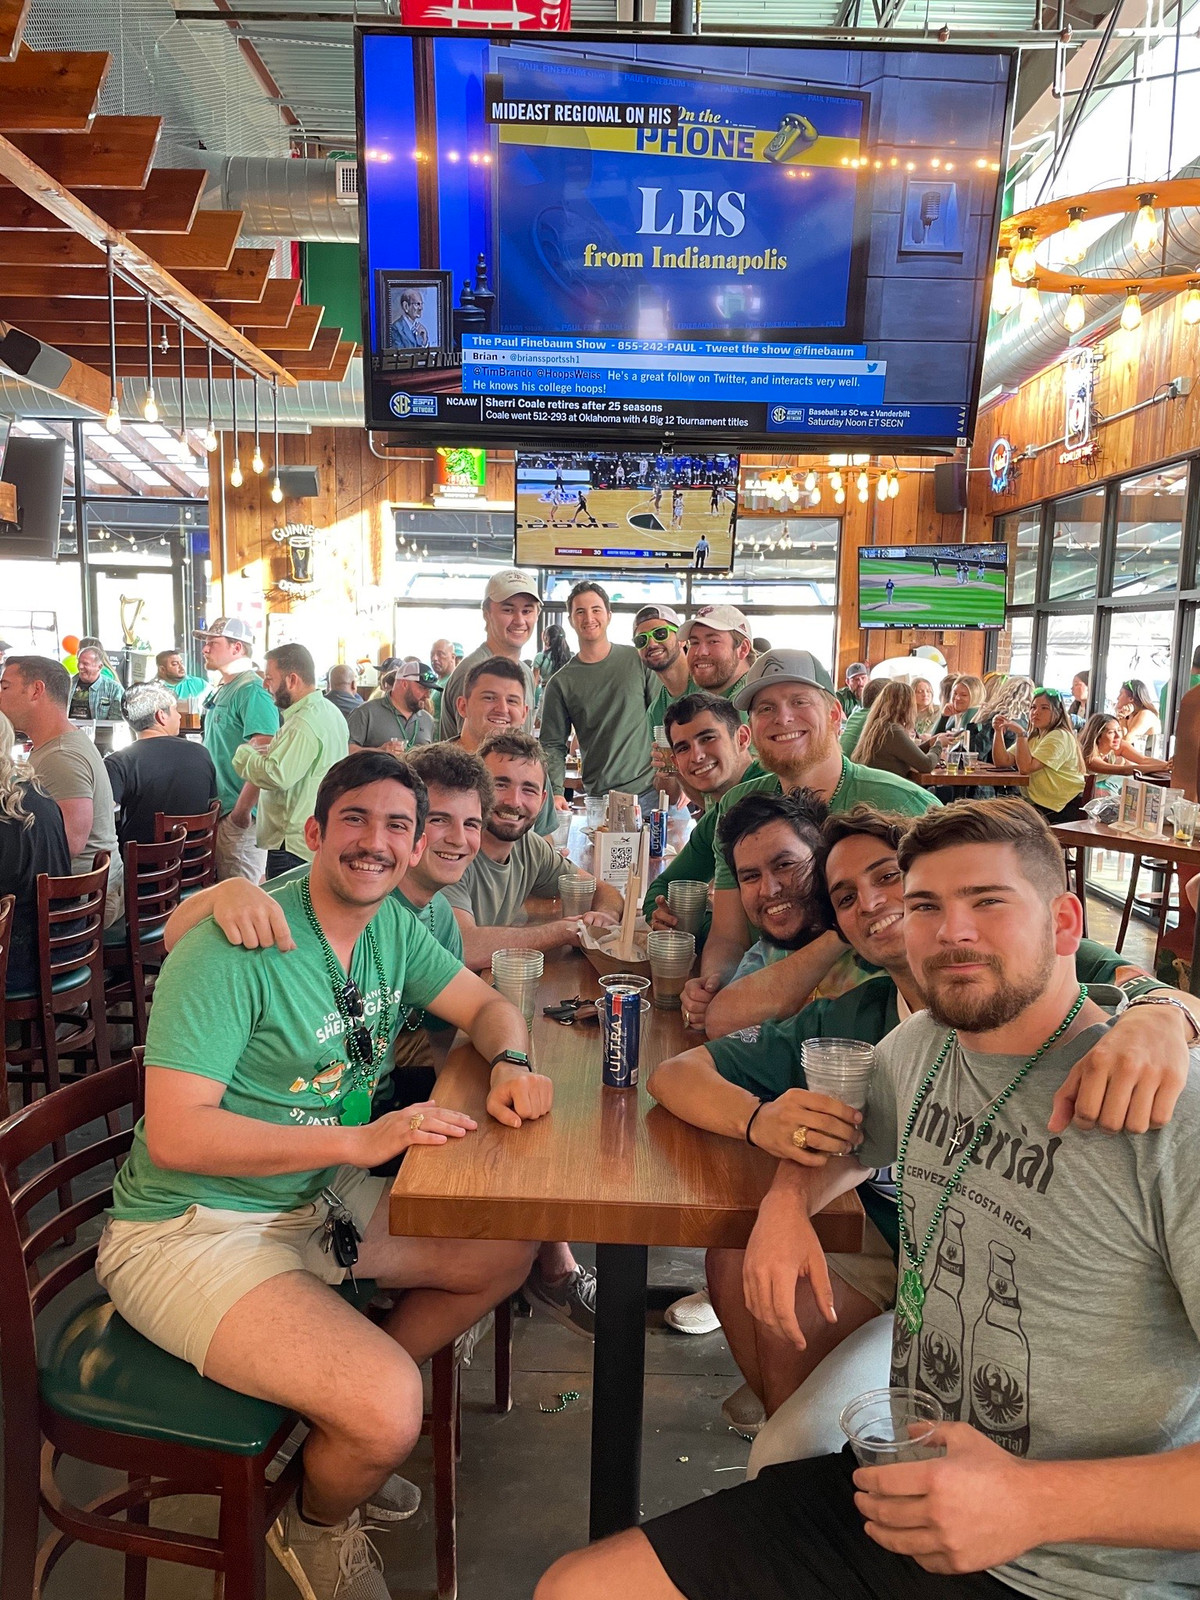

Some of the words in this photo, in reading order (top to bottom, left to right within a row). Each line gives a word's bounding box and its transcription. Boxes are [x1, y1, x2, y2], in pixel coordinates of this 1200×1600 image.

[491, 102, 552, 121] MIDEAST
[554, 104, 622, 124] REGIONAL
[625, 106, 645, 124] ON
[648, 107, 672, 125] HIS
[699, 108, 722, 124] the
[636, 126, 755, 160] PHONE
[635, 187, 746, 238] LES
[583, 243, 644, 268] from
[651, 246, 788, 275] Indianapolis
[472, 336, 492, 346] The
[494, 337, 518, 347] Paul
[521, 338, 574, 349] Finebaum
[576, 340, 607, 350] Show
[617, 341, 697, 352] 855-242-PAUL
[705, 343, 739, 354] Tweet
[742, 344, 759, 354] the
[761, 345, 791, 355] show
[793, 346, 854, 357] @finebaum
[473, 352, 498, 361] Brian
[509, 354, 581, 365] @brianssportssh1
[473, 367, 533, 377] @TimBrando
[536, 368, 601, 379] @HoopsWeiss
[607, 371, 629, 381] He's
[640, 372, 665, 382] great
[667, 372, 696, 383] follow
[698, 375, 710, 383] on
[713, 373, 748, 385] Twitter,
[750, 374, 769, 385] and
[772, 375, 813, 386] interacts
[816, 379, 836, 388] very
[838, 377, 861, 387] well.
[473, 380, 486, 390] He
[489, 381, 519, 391] knows
[521, 382, 536, 391] his
[538, 382, 572, 394] college
[575, 384, 606, 394] hoops!
[393, 395, 411, 415] SEC
[446, 397, 478, 406] NCAAW
[485, 397, 516, 408] Sherri
[518, 398, 546, 409] Coale
[548, 399, 580, 410] retires
[581, 400, 606, 411] after
[608, 401, 621, 411] 25
[623, 403, 663, 412] seasons
[485, 410, 510, 420] Coale
[511, 412, 532, 421] went
[533, 411, 567, 421] 512-293
[568, 413, 578, 422] at
[579, 413, 621, 423] Oklahoma
[622, 414, 641, 424] with
[642, 415, 648, 424] 4
[649, 415, 664, 426] Big
[665, 415, 675, 425] 12
[677, 415, 726, 427] Tournament
[728, 416, 749, 427] titles
[773, 408, 785, 422] SEC
[808, 408, 840, 417] Baseball:
[848, 409, 859, 417] SC
[875, 410, 911, 418] Vanderbilt
[807, 417, 844, 428] Saturday
[845, 418, 867, 427] Noon
[868, 418, 880, 427] ET
[880, 419, 904, 428] SECN
[652, 823, 661, 850] ULTRA
[609, 1018, 622, 1072] ULTRA
[289, 1107, 306, 1124] ST.
[968, 1189, 1001, 1218] COSTA
[1002, 1210, 1033, 1241] RICA
